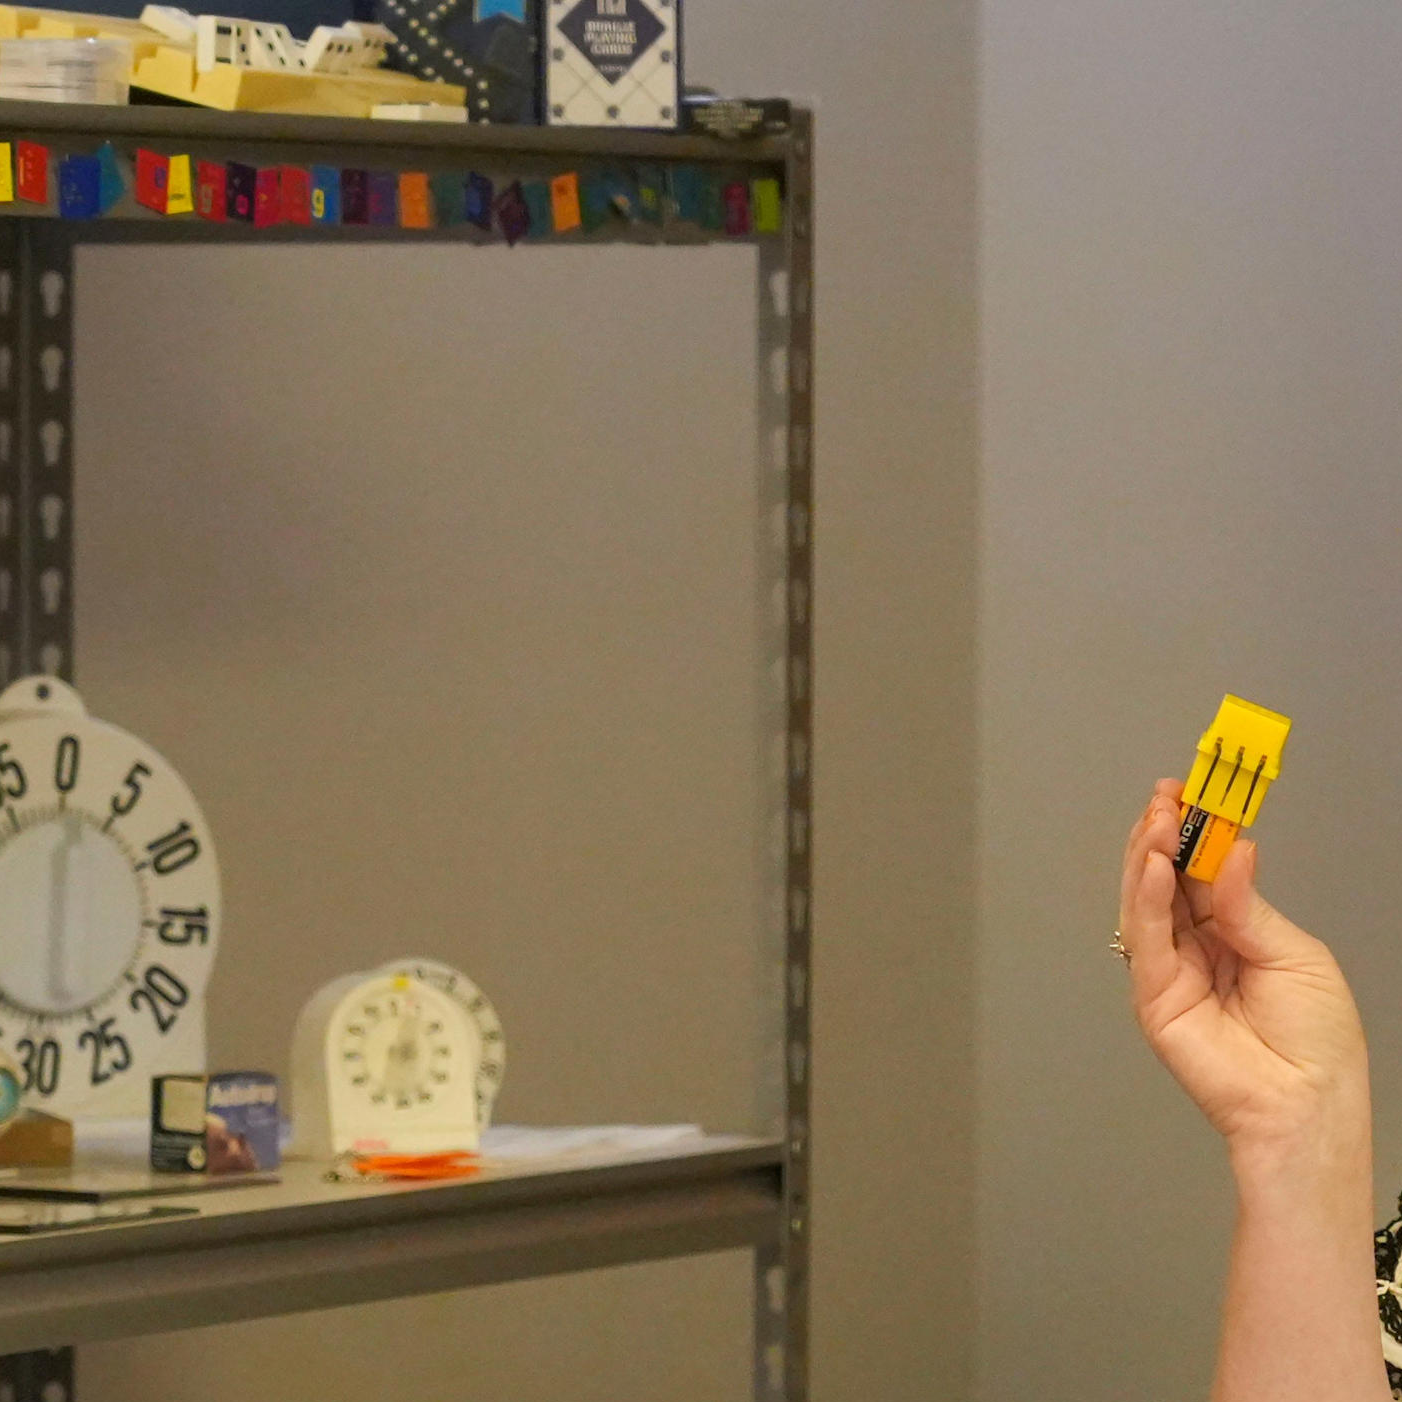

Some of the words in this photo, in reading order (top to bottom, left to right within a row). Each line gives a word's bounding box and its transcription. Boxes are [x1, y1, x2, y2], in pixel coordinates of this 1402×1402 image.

[54, 735, 81, 793] 0
[110, 762, 153, 817] 5
[146, 820, 202, 876] 10
[157, 905, 209, 946] 15
[130, 964, 190, 1034] 20
[15, 1037, 62, 1097] 30
[78, 1016, 133, 1087] 25
